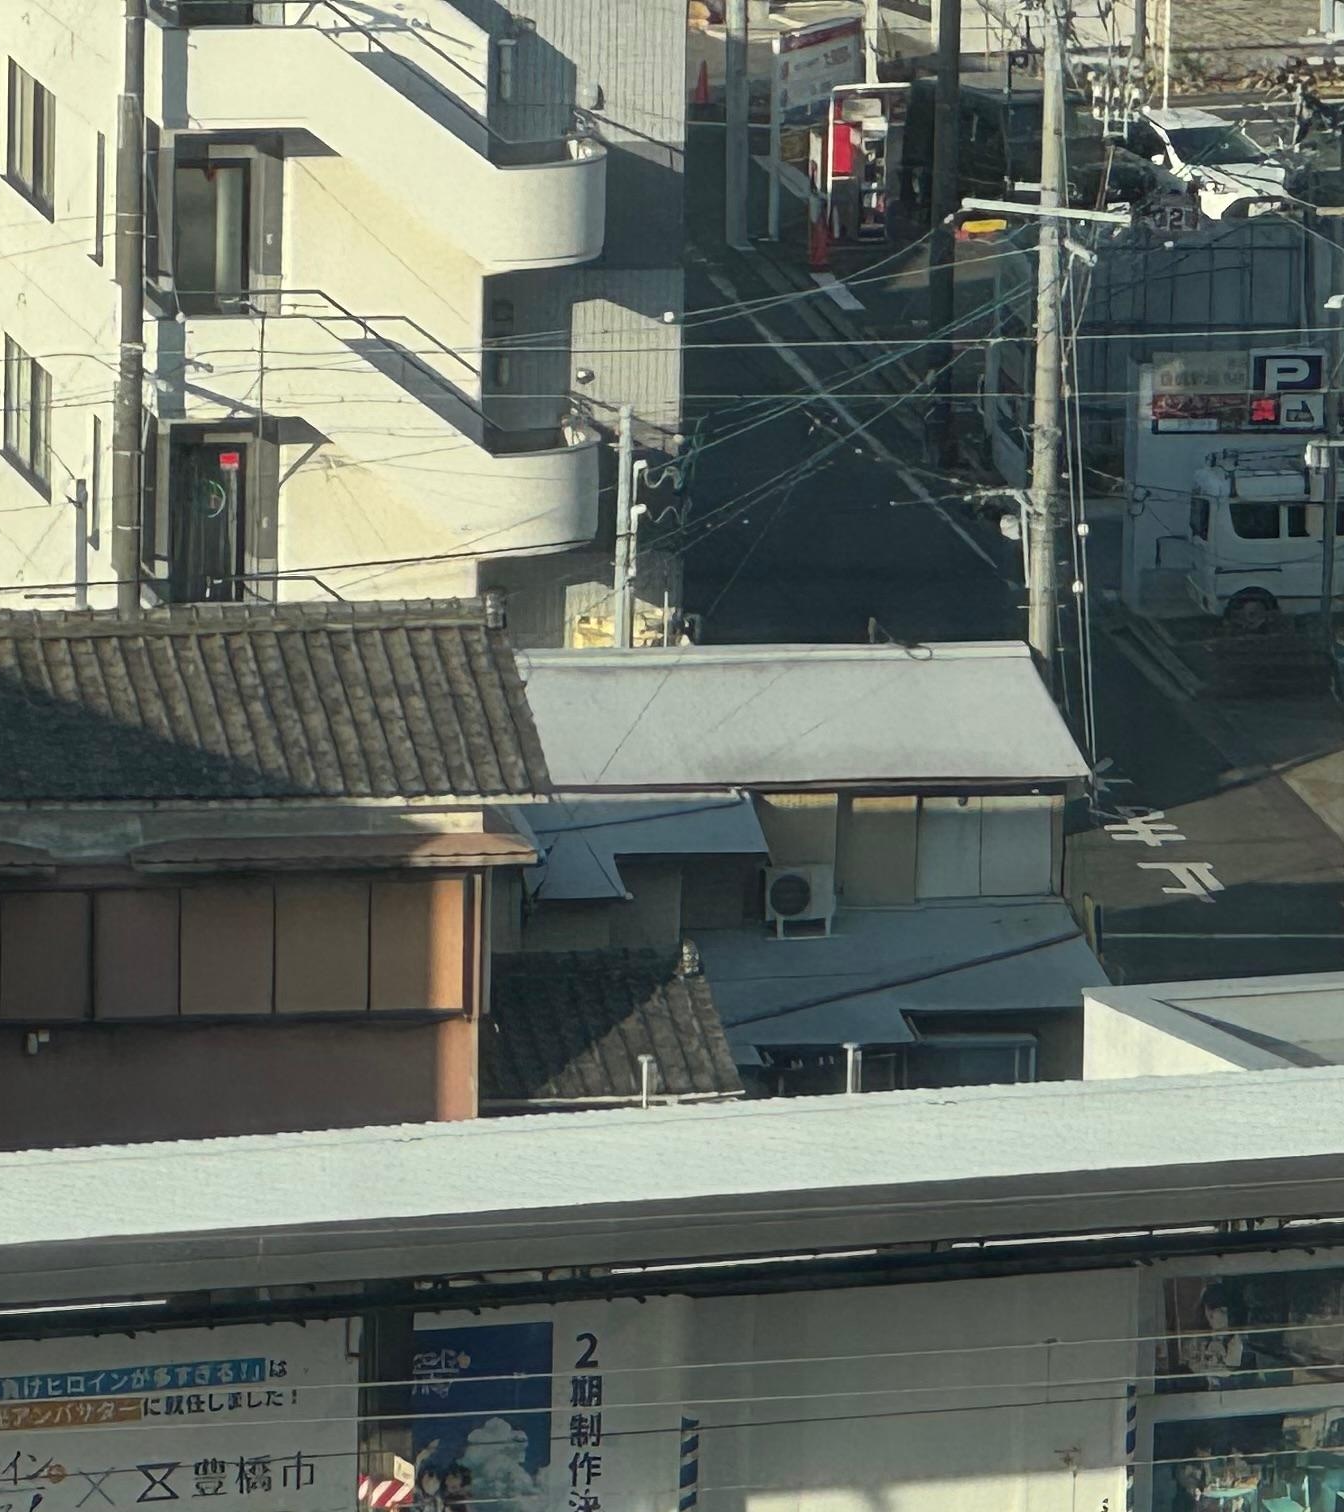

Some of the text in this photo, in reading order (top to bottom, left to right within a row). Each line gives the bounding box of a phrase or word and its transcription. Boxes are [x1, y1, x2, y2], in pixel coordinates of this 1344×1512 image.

[1266, 358, 1310, 393] P
[191, 1449, 317, 1499] 豊橋市
